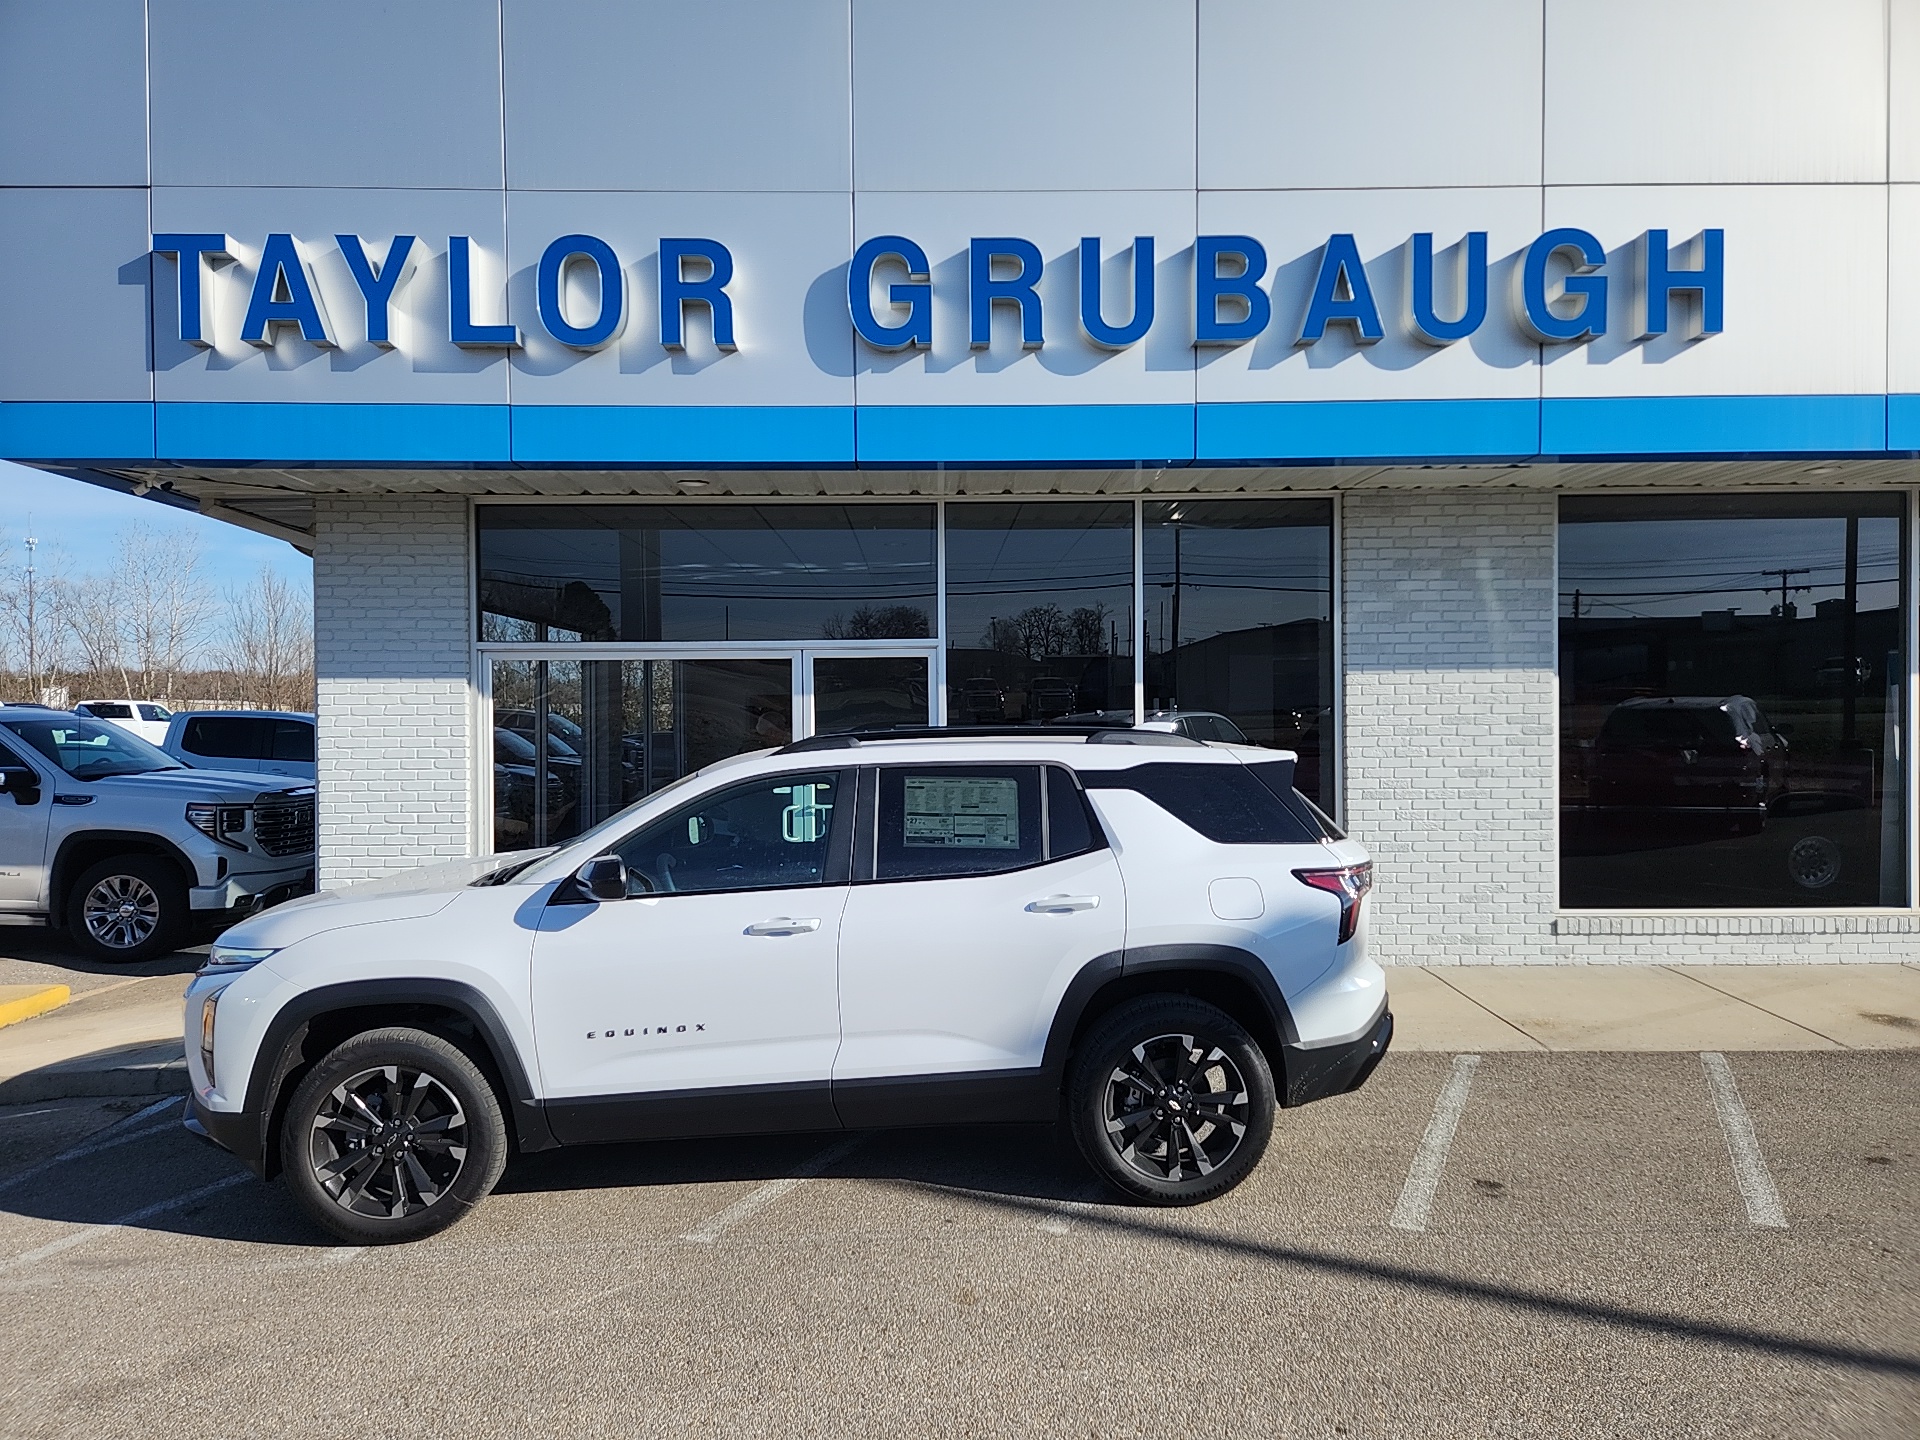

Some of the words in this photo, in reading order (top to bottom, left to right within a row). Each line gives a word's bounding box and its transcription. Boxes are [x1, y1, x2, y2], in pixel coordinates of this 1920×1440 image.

[152, 233, 738, 353] TAYLOR
[846, 227, 1726, 349] GRUBAUGH
[586, 1022, 706, 1040] EQUINOX
